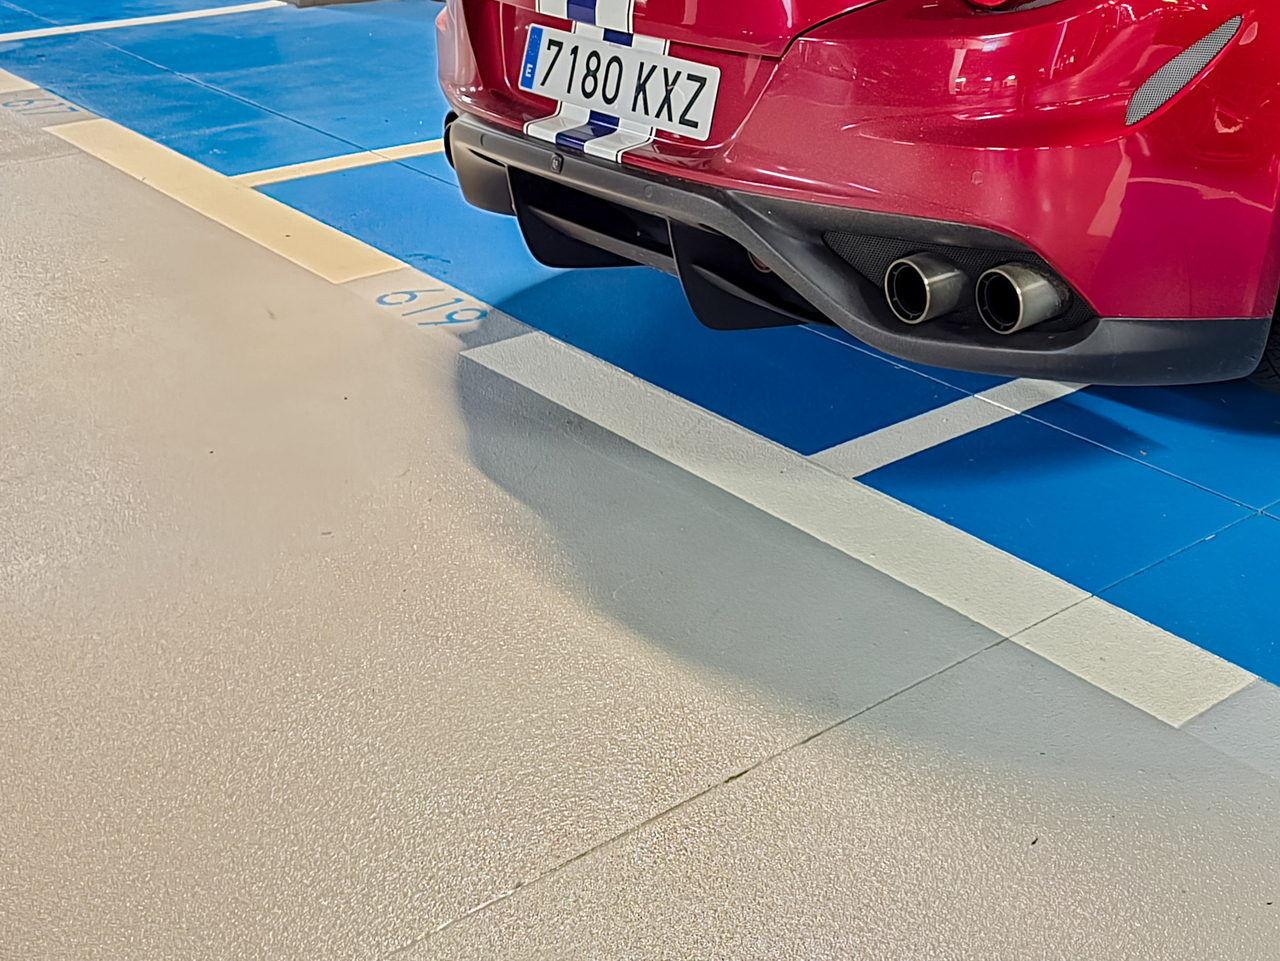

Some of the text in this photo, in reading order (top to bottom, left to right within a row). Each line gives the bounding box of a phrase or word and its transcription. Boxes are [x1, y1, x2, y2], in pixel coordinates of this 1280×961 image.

[525, 63, 534, 78] E
[540, 38, 708, 130] 7180 KXZ
[376, 288, 488, 327] 619
